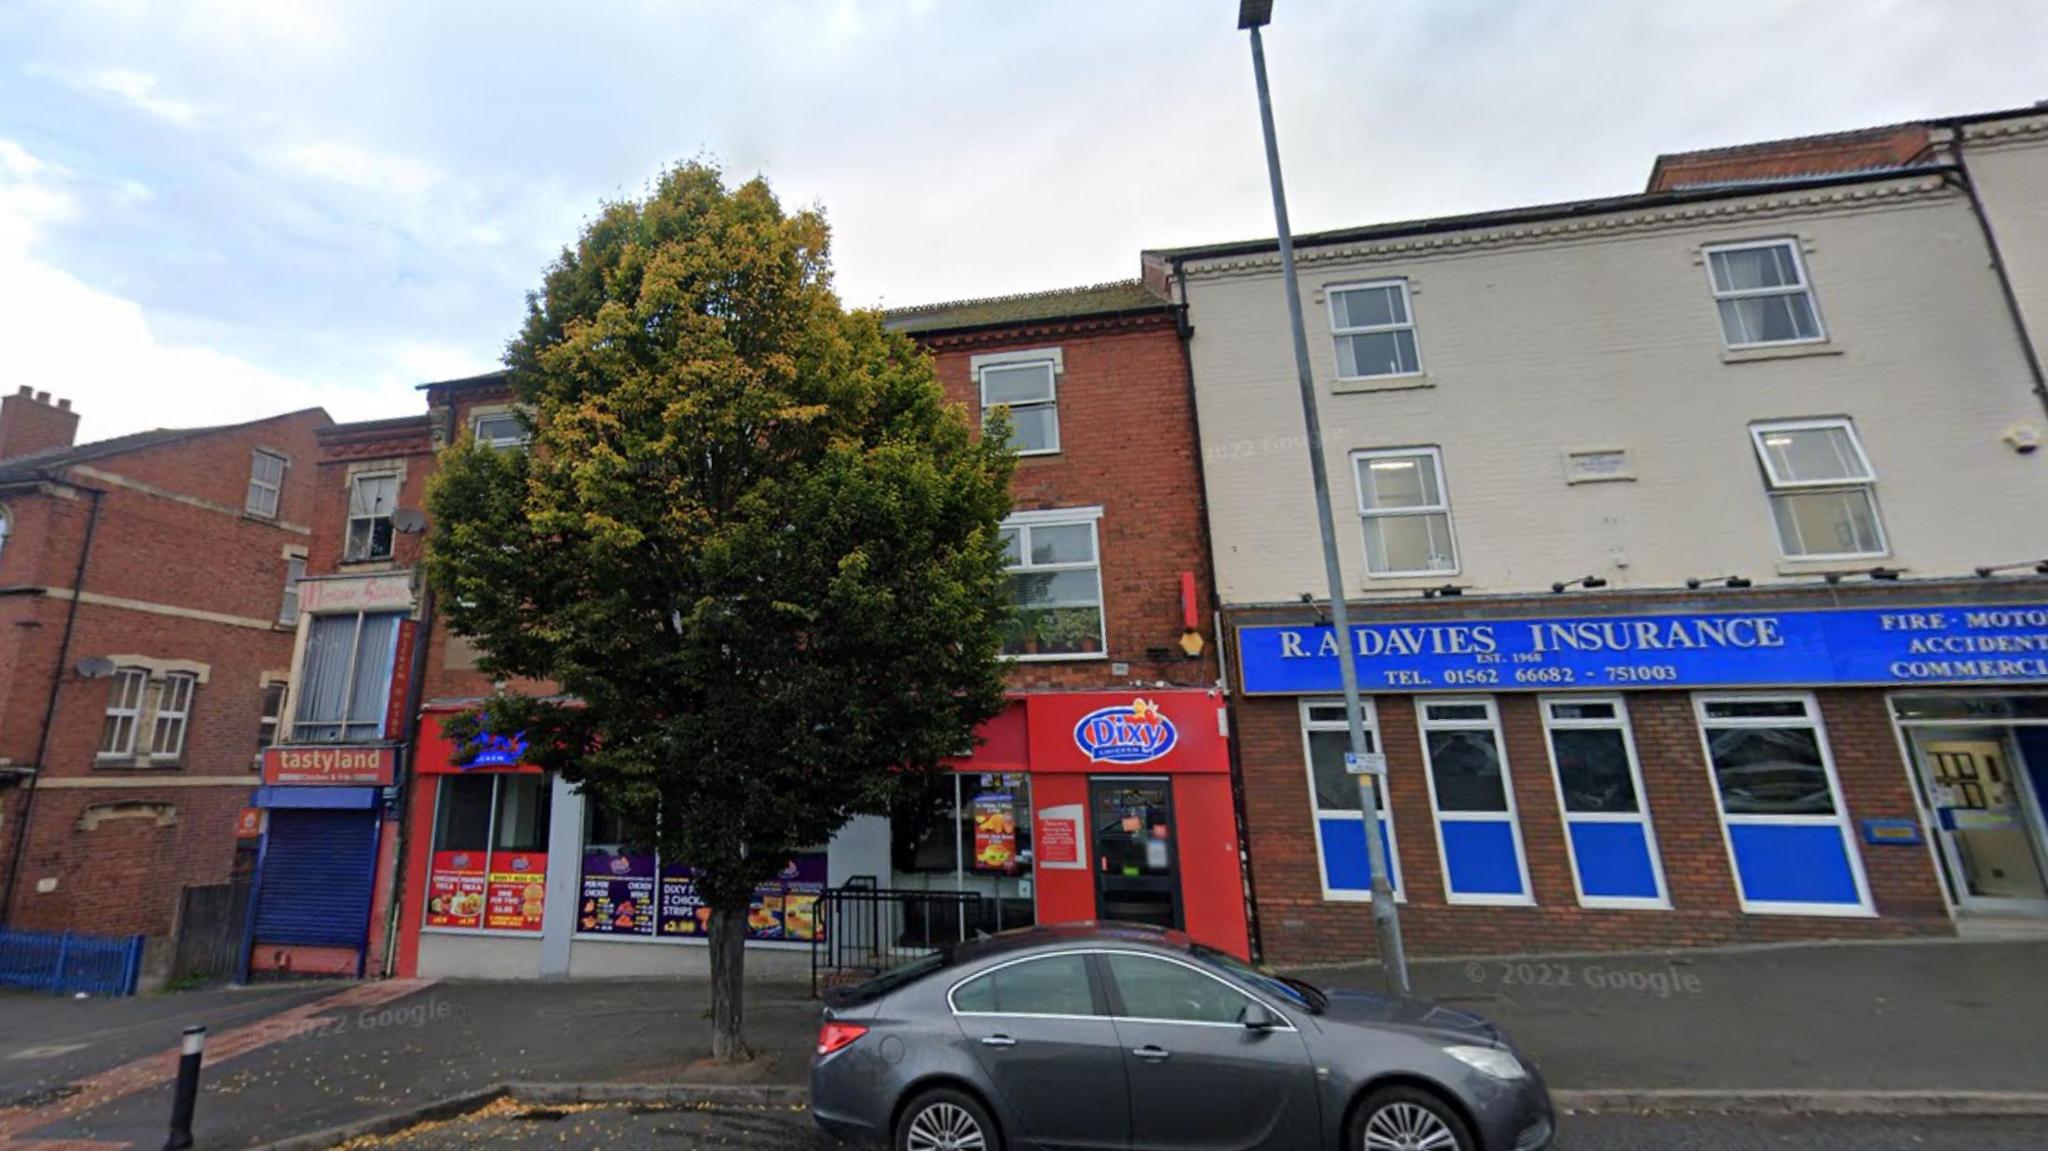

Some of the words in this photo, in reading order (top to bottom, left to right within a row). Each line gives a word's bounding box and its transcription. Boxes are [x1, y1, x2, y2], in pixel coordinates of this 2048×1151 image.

[1881, 613, 1948, 630] FIRE
[1280, 632, 1311, 657] R.
[1356, 626, 1496, 655] DAVIES
[1529, 617, 1784, 651] INSURANCE
[1910, 635, 2048, 653] ACCIDENT
[1384, 670, 1432, 685] TEL.
[1444, 668, 1499, 684] 01562
[1515, 668, 1575, 683] 66682
[1605, 665, 1677, 681] 751003
[1090, 714, 1163, 751] Dixy
[280, 750, 380, 773] tastyland
[671, 895, 706, 905] CHICK
